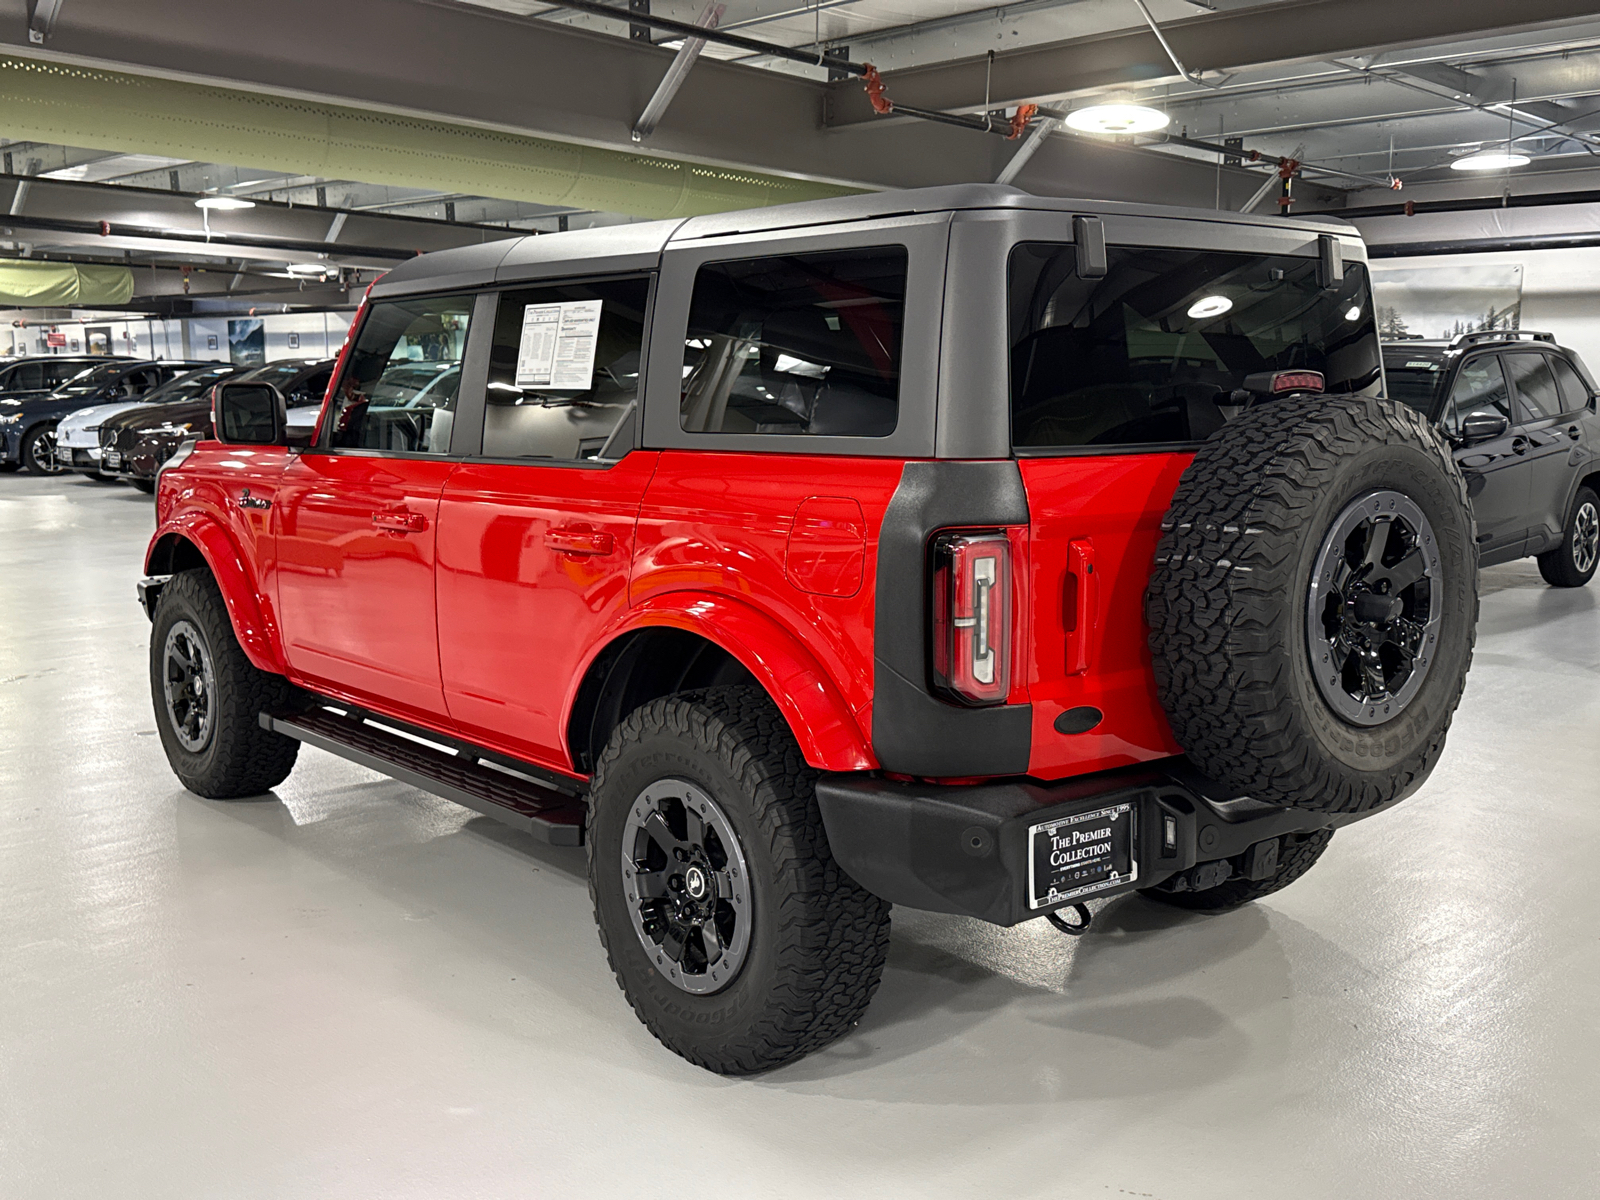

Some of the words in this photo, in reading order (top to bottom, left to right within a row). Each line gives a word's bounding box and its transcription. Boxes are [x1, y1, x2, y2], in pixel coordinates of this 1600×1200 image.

[1051, 835, 1071, 851] THE
[1072, 827, 1112, 844] PREMIER
[1050, 842, 1112, 866] COLLECTION
